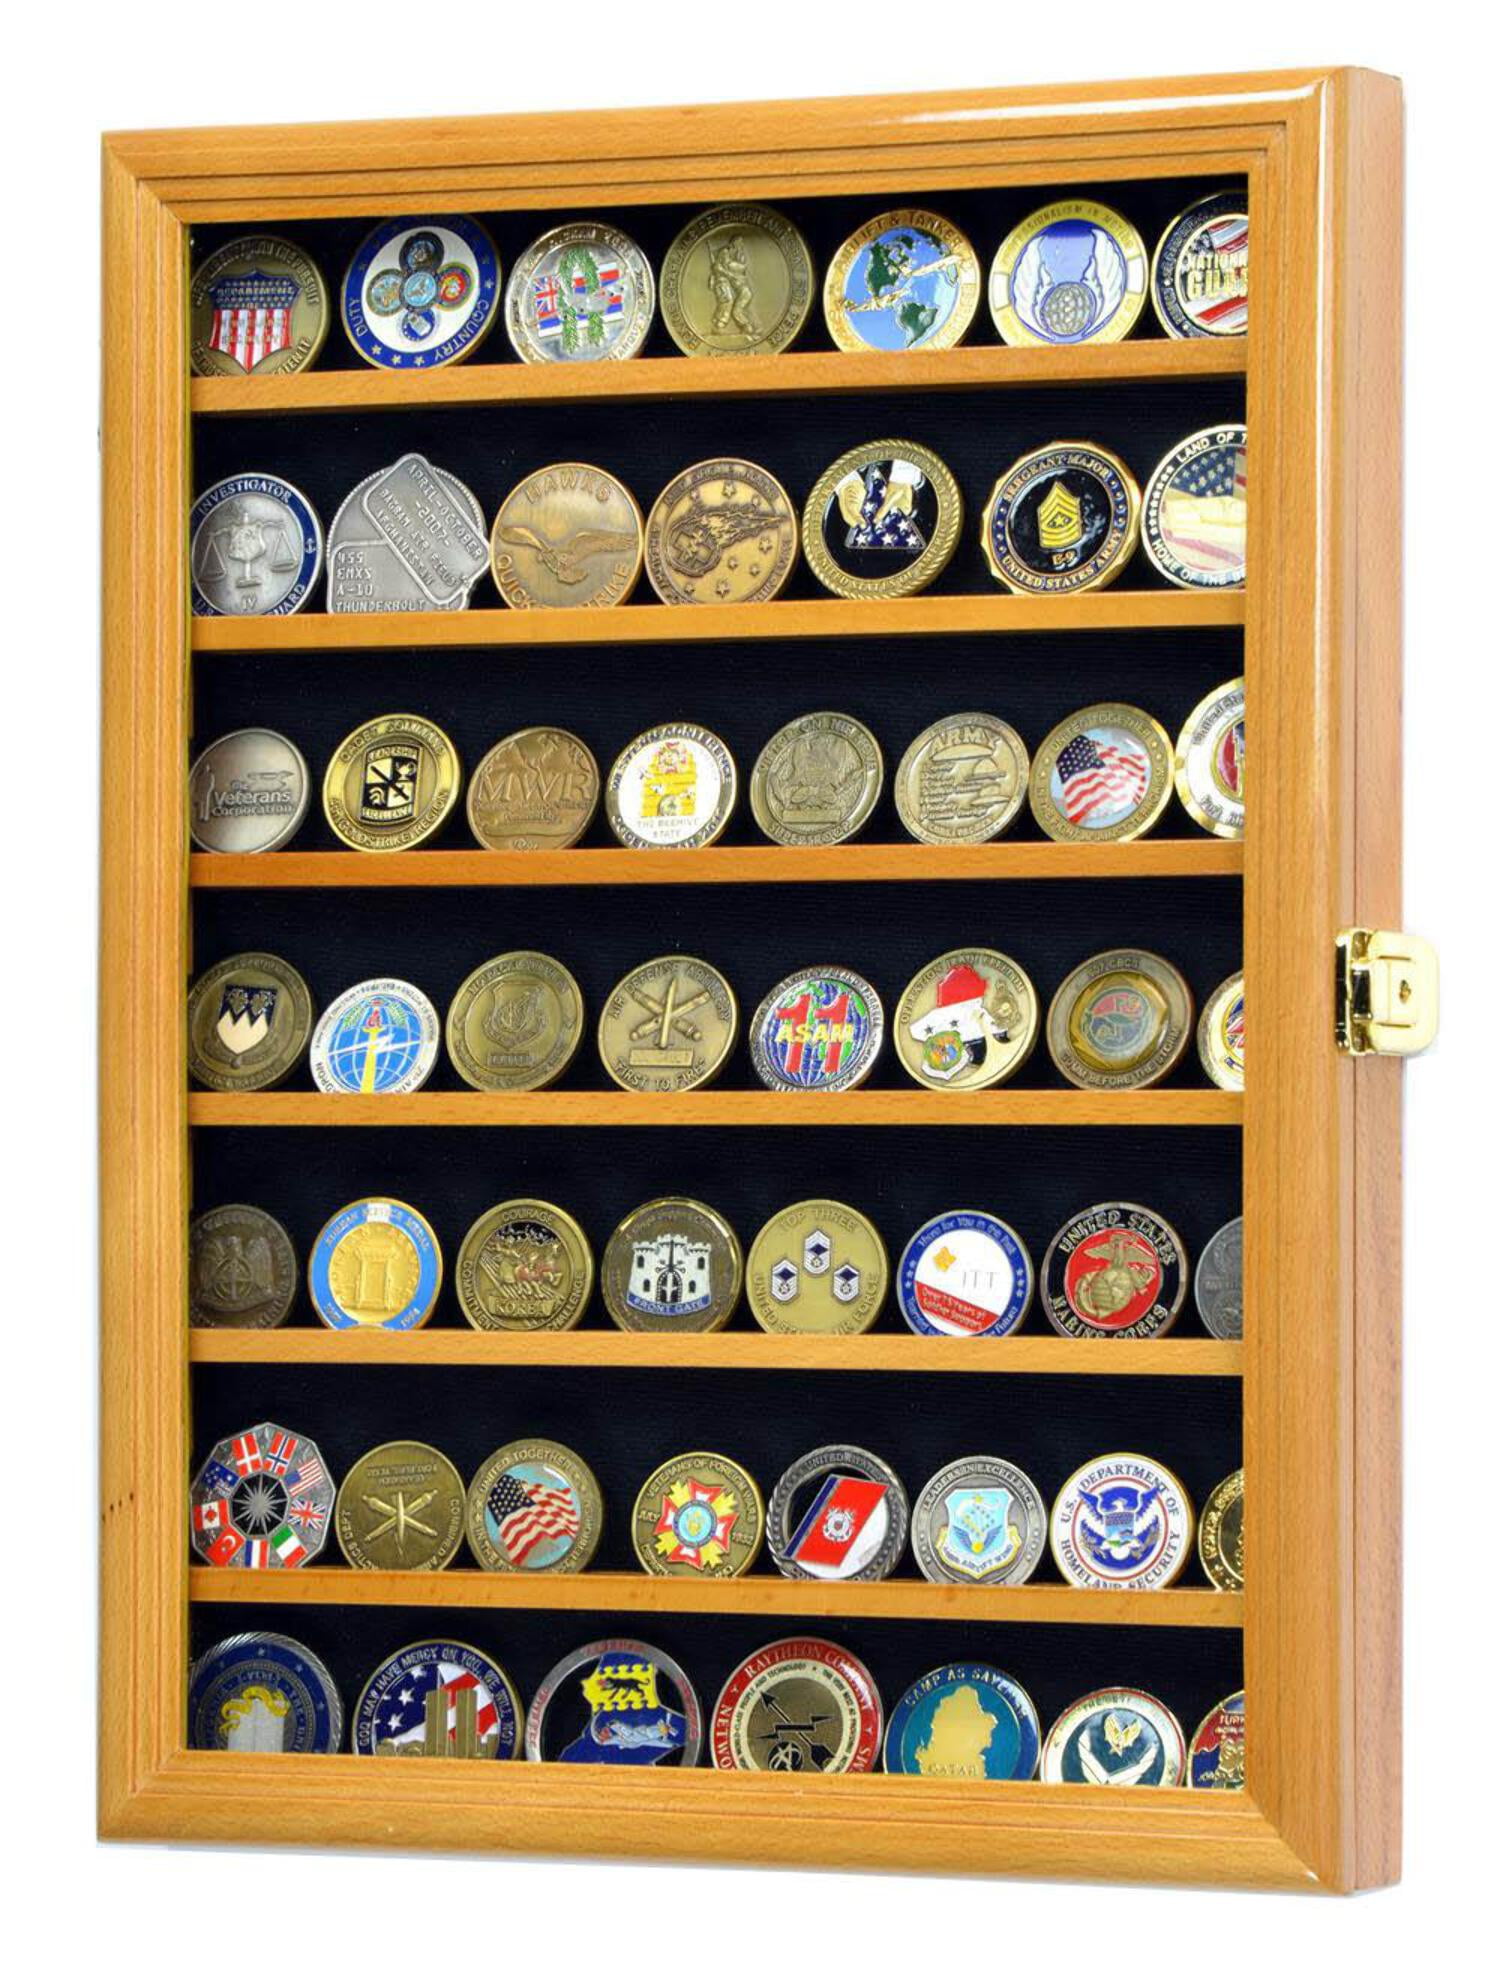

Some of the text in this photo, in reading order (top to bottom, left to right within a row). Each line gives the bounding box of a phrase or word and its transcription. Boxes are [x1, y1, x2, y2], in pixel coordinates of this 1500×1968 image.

[908, 211, 963, 249] TANKER
[349, 301, 368, 337] DUTY
[434, 299, 490, 362] COUNTRY
[1176, 431, 1236, 464] LAND OF
[199, 479, 292, 515] INVESTIGATOR
[524, 469, 612, 505] HAWKS
[378, 487, 410, 529] BAGRAM
[410, 529, 431, 552] AIR
[407, 463, 483, 562] APRIL-OCTOBER
[376, 508, 435, 587] AFGHANISTAN
[1002, 528, 1122, 588] UNITED STATES ARMY
[1151, 536, 1182, 575] HOME
[1179, 568, 1196, 584] OF
[336, 567, 373, 580] EMXS
[268, 583, 306, 616] UARD
[335, 599, 425, 613] THUNDERBOLT
[340, 720, 448, 763] CADET COMMAND
[799, 719, 822, 734] ON
[931, 726, 1001, 755] ARMY
[214, 790, 292, 806] Veterans
[479, 771, 592, 801] MWR
[211, 804, 295, 817] Corporation
[657, 817, 700, 828] BEEHIVE
[653, 828, 682, 838] STATE
[609, 962, 731, 1022] AIR DEFENSE ARTILLERY
[900, 963, 944, 1025] OPERATION
[775, 1023, 855, 1043] ASAM
[615, 1058, 706, 1091] FIRST TO FIRE
[1088, 1072, 1134, 1087] BEFORE
[502, 1208, 554, 1225] COURAGE
[780, 1206, 858, 1233] TOP THREE
[1057, 1209, 1178, 1267] UNITED STATES
[462, 1260, 500, 1330] COMMITMENT
[962, 1269, 1001, 1289] ITT
[494, 1299, 548, 1318] KOREA
[632, 1298, 705, 1314] FRONT GATE
[751, 1271, 779, 1327] UNITED
[852, 1271, 881, 1323] FORCE
[1049, 1295, 1170, 1340] MARINE CORPS
[478, 1446, 573, 1494] UNITED TOGETHER
[805, 1452, 845, 1470] UNITED
[647, 1458, 758, 1523] VETERANS OF FOREIGN WARS
[977, 1463, 1035, 1511] EXCELLENCE
[1060, 1463, 1180, 1524] U.S. DEPARTMENT OF
[1060, 1530, 1181, 1589] HOMELAND SECURITY
[401, 1646, 440, 1668] MERCY
[441, 1646, 459, 1661] ON
[744, 1642, 824, 1679] RAYTHEON
[767, 1662, 808, 1678] TECHNOLOGY
[375, 1662, 404, 1691] HAVE
[484, 1669, 501, 1688] WE
[903, 1668, 967, 1706] CAMP AS
[362, 1688, 380, 1717] MAY
[495, 1688, 511, 1718] WILL
[359, 1722, 371, 1747] GOD
[502, 1719, 515, 1747] NOT
[716, 1702, 735, 1770] NETWO
